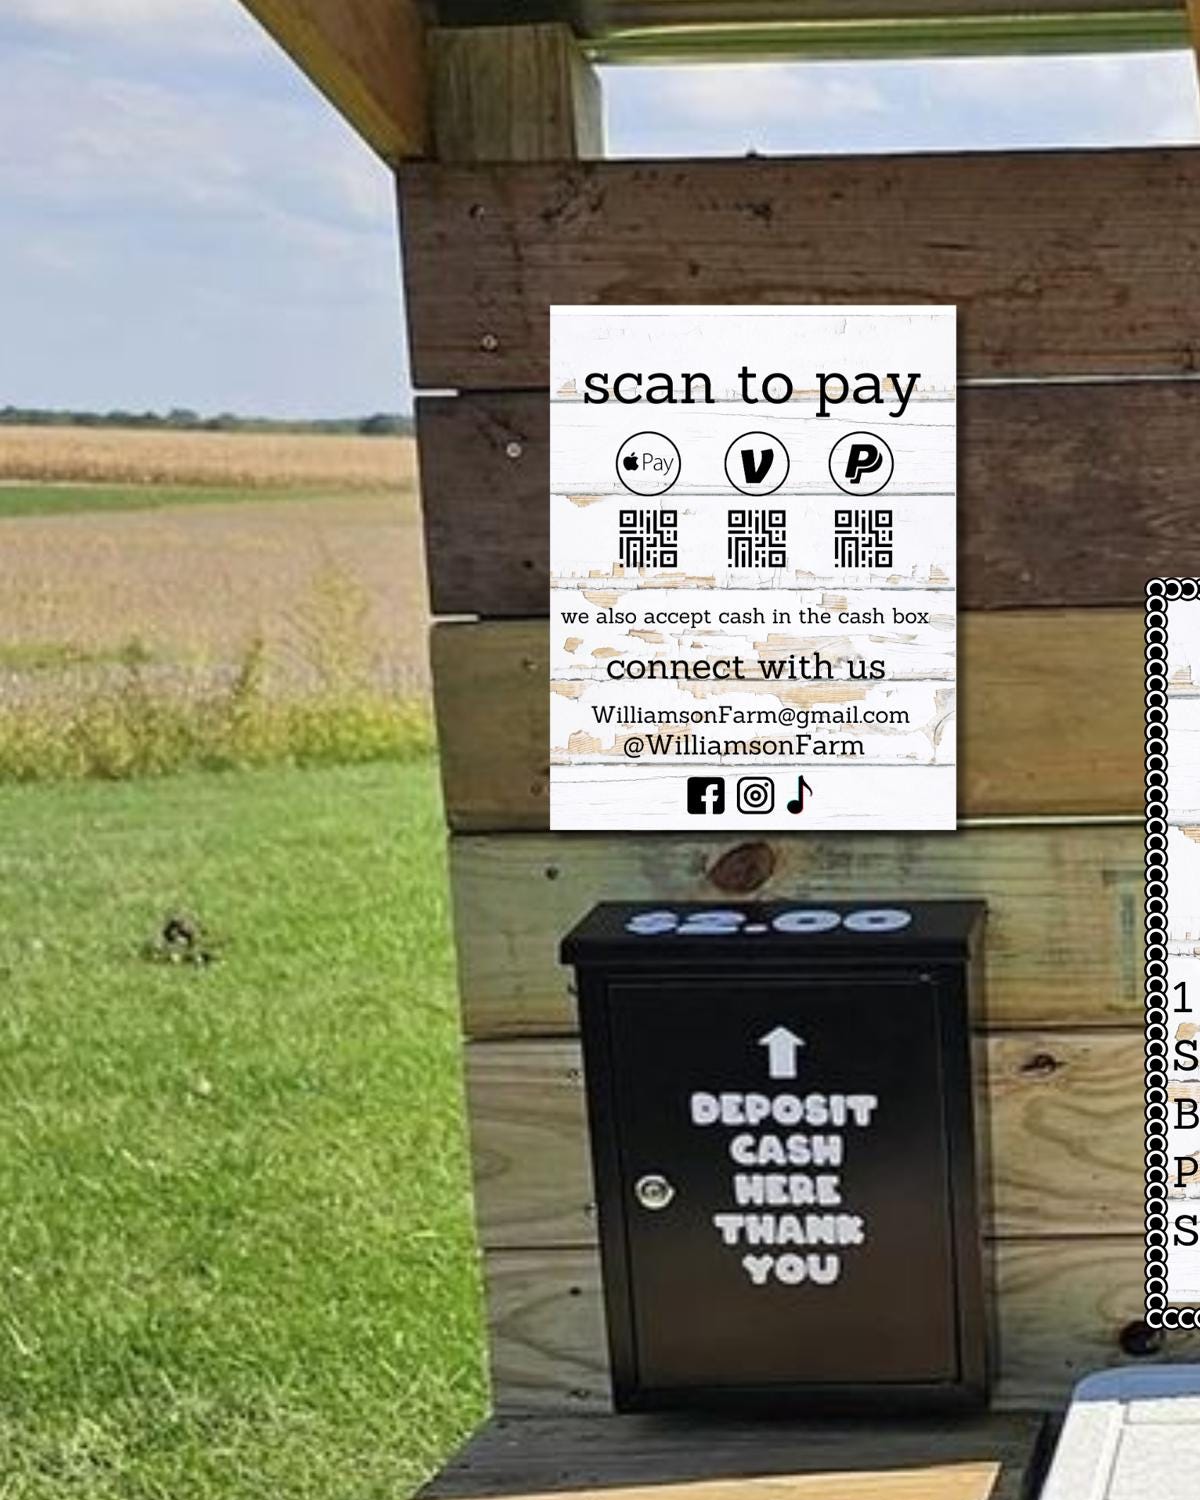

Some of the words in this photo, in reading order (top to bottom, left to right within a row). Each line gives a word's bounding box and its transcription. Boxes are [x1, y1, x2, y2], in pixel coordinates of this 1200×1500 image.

[584, 372, 716, 405] scan
[737, 366, 793, 405] to
[815, 372, 921, 418] pay
[642, 452, 674, 476] Pay
[560, 612, 589, 624] we
[596, 607, 637, 624] also
[644, 609, 712, 629] accept
[718, 607, 766, 624] cash
[772, 612, 791, 624] in
[798, 607, 831, 624] the
[838, 607, 885, 624] cash
[892, 607, 929, 624] box
[606, 656, 746, 680] connect
[757, 651, 834, 680] with
[847, 660, 886, 680] us
[591, 705, 910, 729] WilliamsonFarm@gmail.com
[623, 734, 865, 759] @WilliamsonFarm
[625, 909, 912, 936] $2.00
[1173, 981, 1193, 1013] 1
[691, 1092, 878, 1127] DEPOSIT
[730, 1134, 842, 1166] CASH
[734, 1173, 842, 1206] HERE
[713, 1213, 865, 1245] THANK
[742, 1253, 839, 1285] YOU
